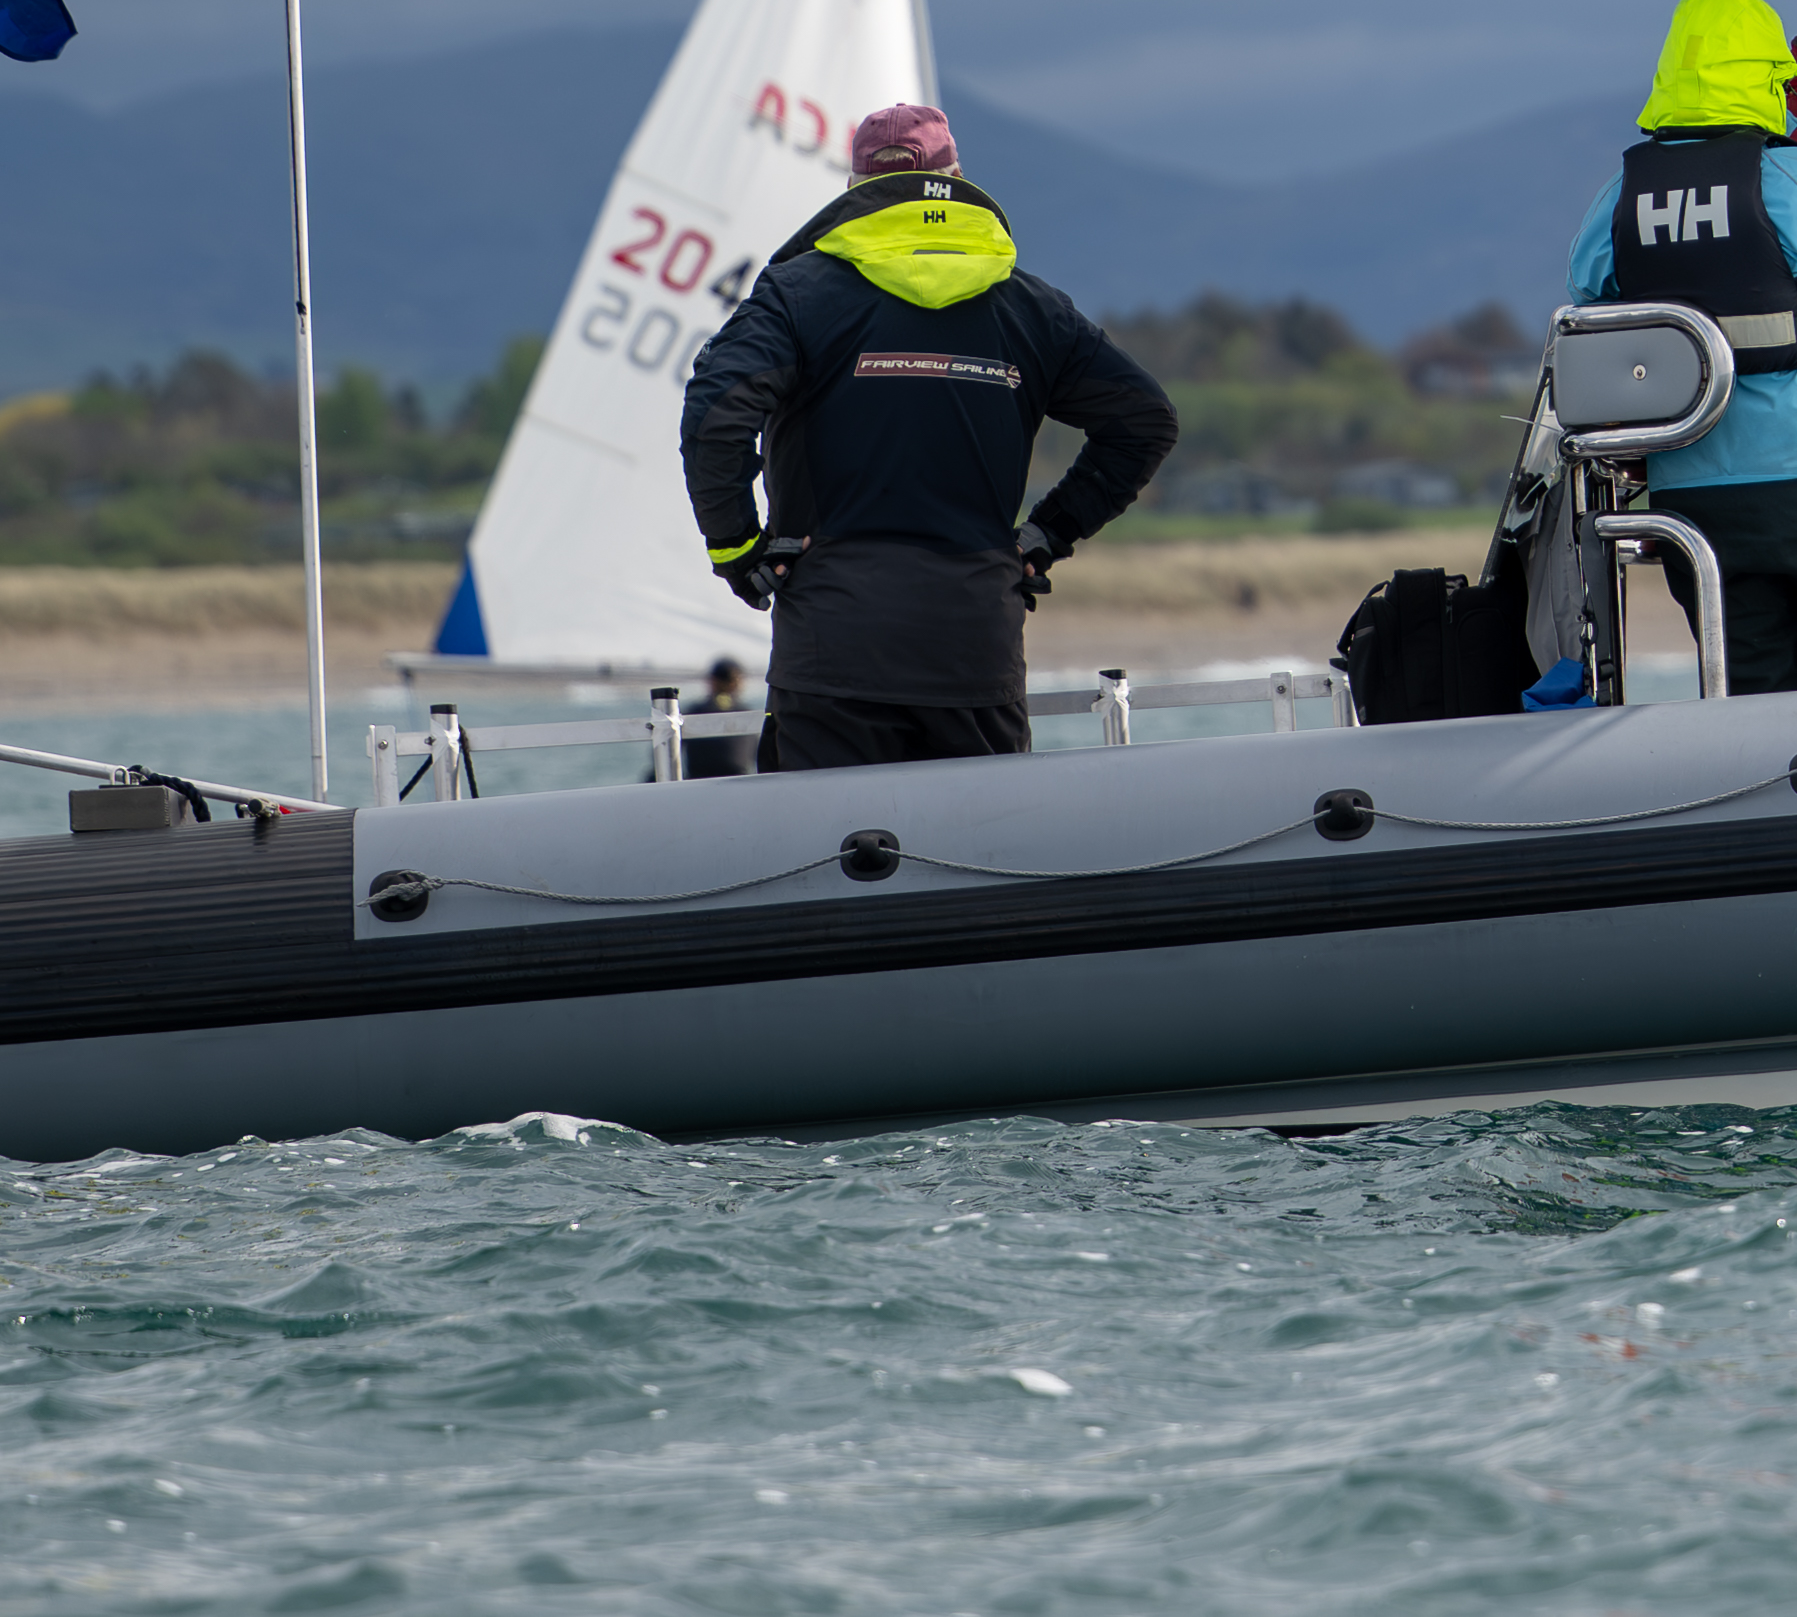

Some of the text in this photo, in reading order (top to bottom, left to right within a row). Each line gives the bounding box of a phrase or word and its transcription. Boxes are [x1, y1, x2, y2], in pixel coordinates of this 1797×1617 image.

[924, 181, 952, 199] HH
[924, 210, 946, 223] HH
[1637, 185, 1730, 245] HH
[860, 359, 949, 370] FAIRVIEW
